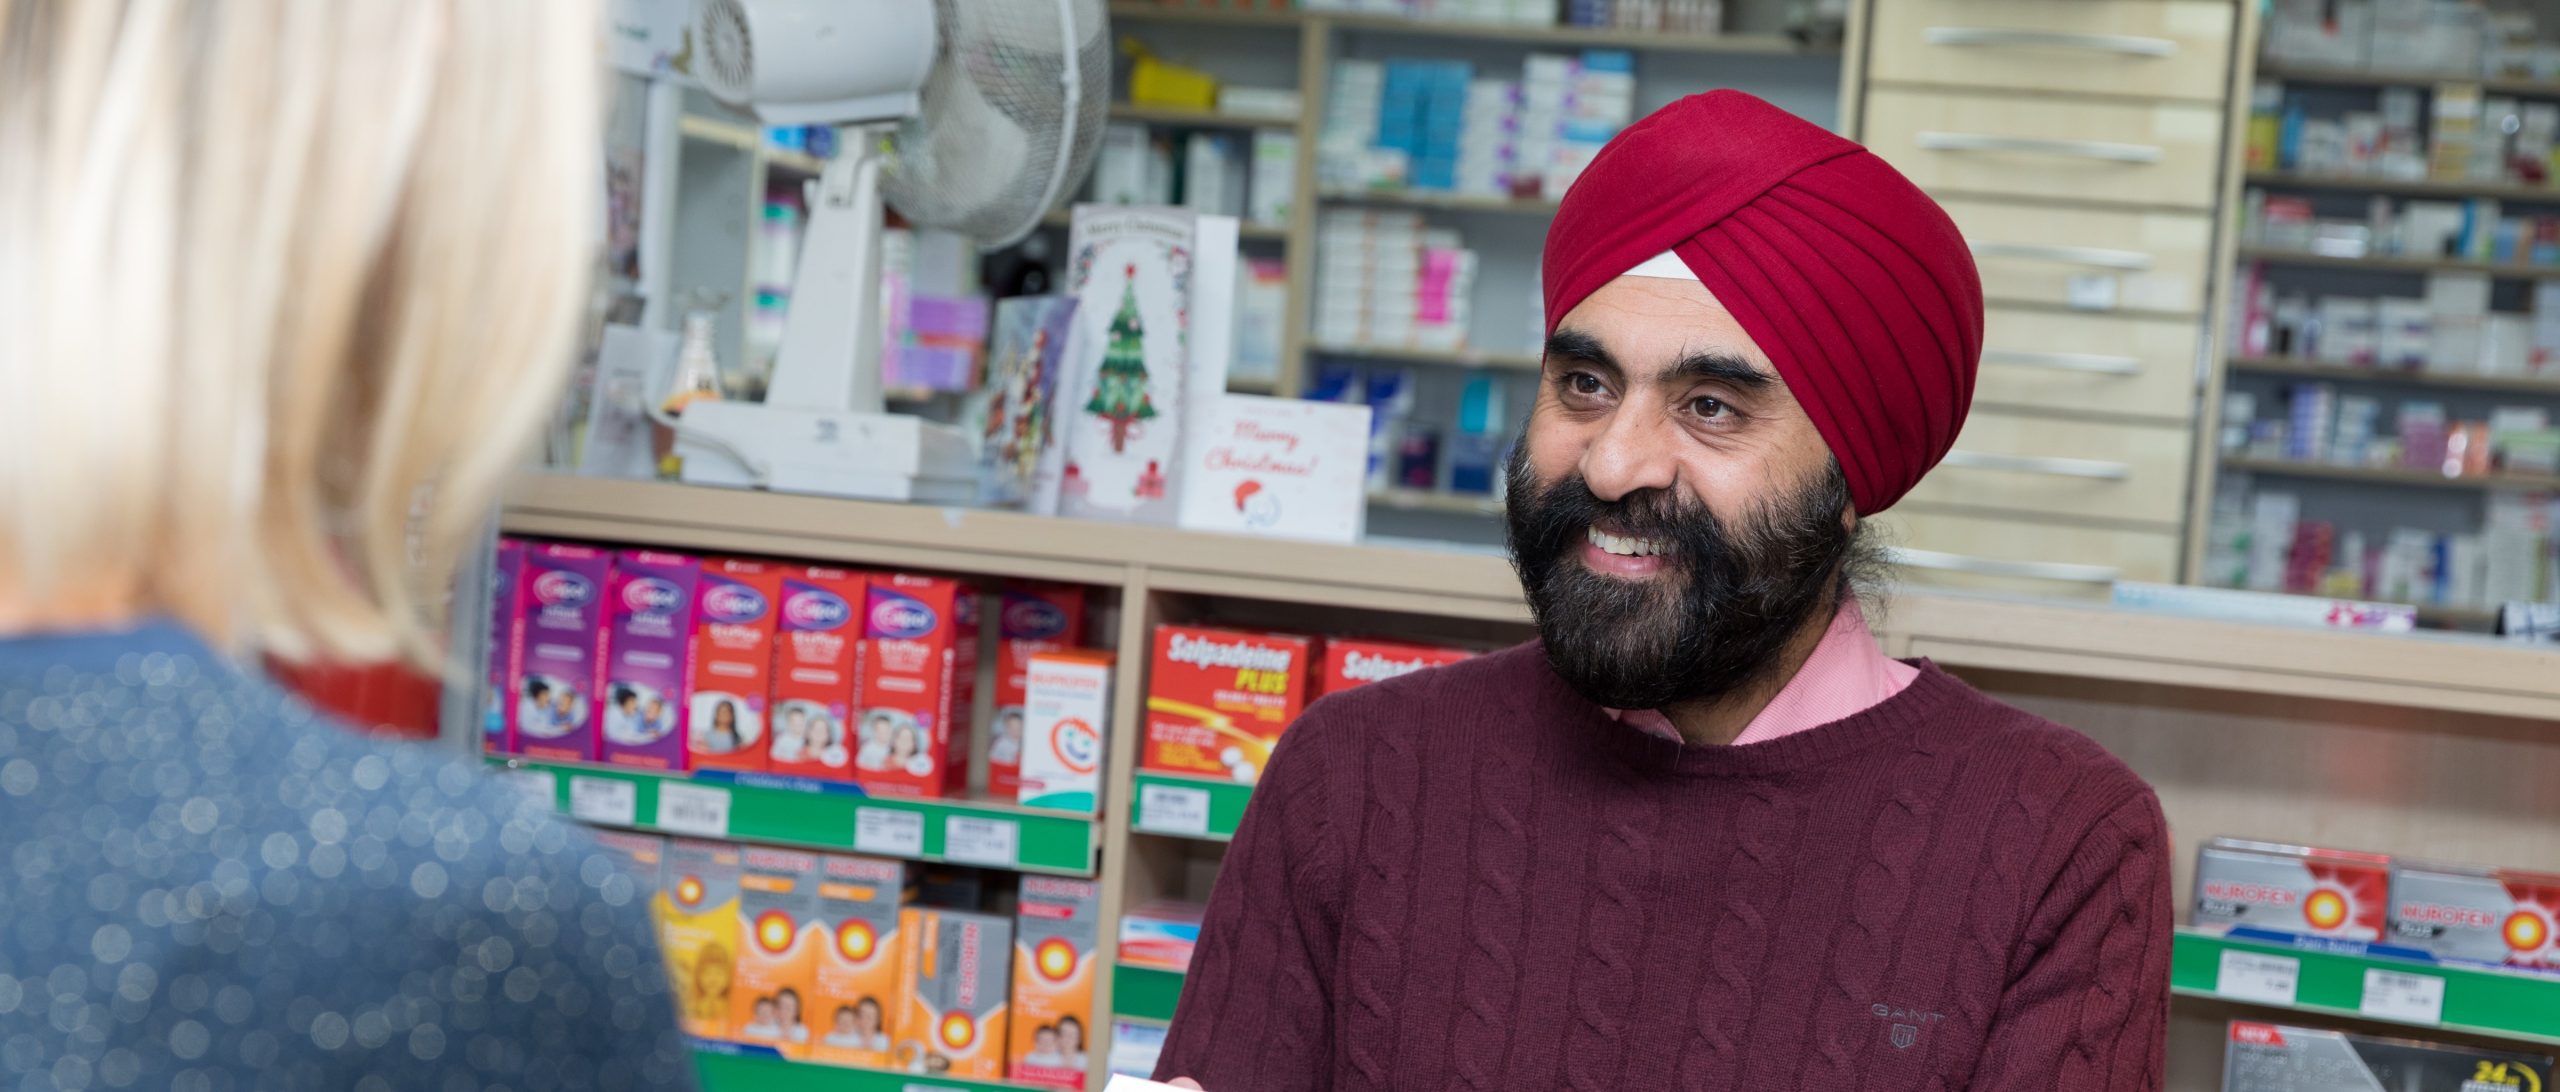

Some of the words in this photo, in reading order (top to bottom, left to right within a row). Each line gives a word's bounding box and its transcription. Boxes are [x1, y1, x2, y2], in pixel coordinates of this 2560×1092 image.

[1166, 633, 1292, 673] Solpadeine
[1234, 668, 1290, 695] PLUS
[2203, 880, 2299, 907] NUROFEN
[2400, 902, 2497, 928] NUROFEN
[957, 920, 982, 1007] NUROFEN
[1871, 1003, 1946, 1024] GANT
